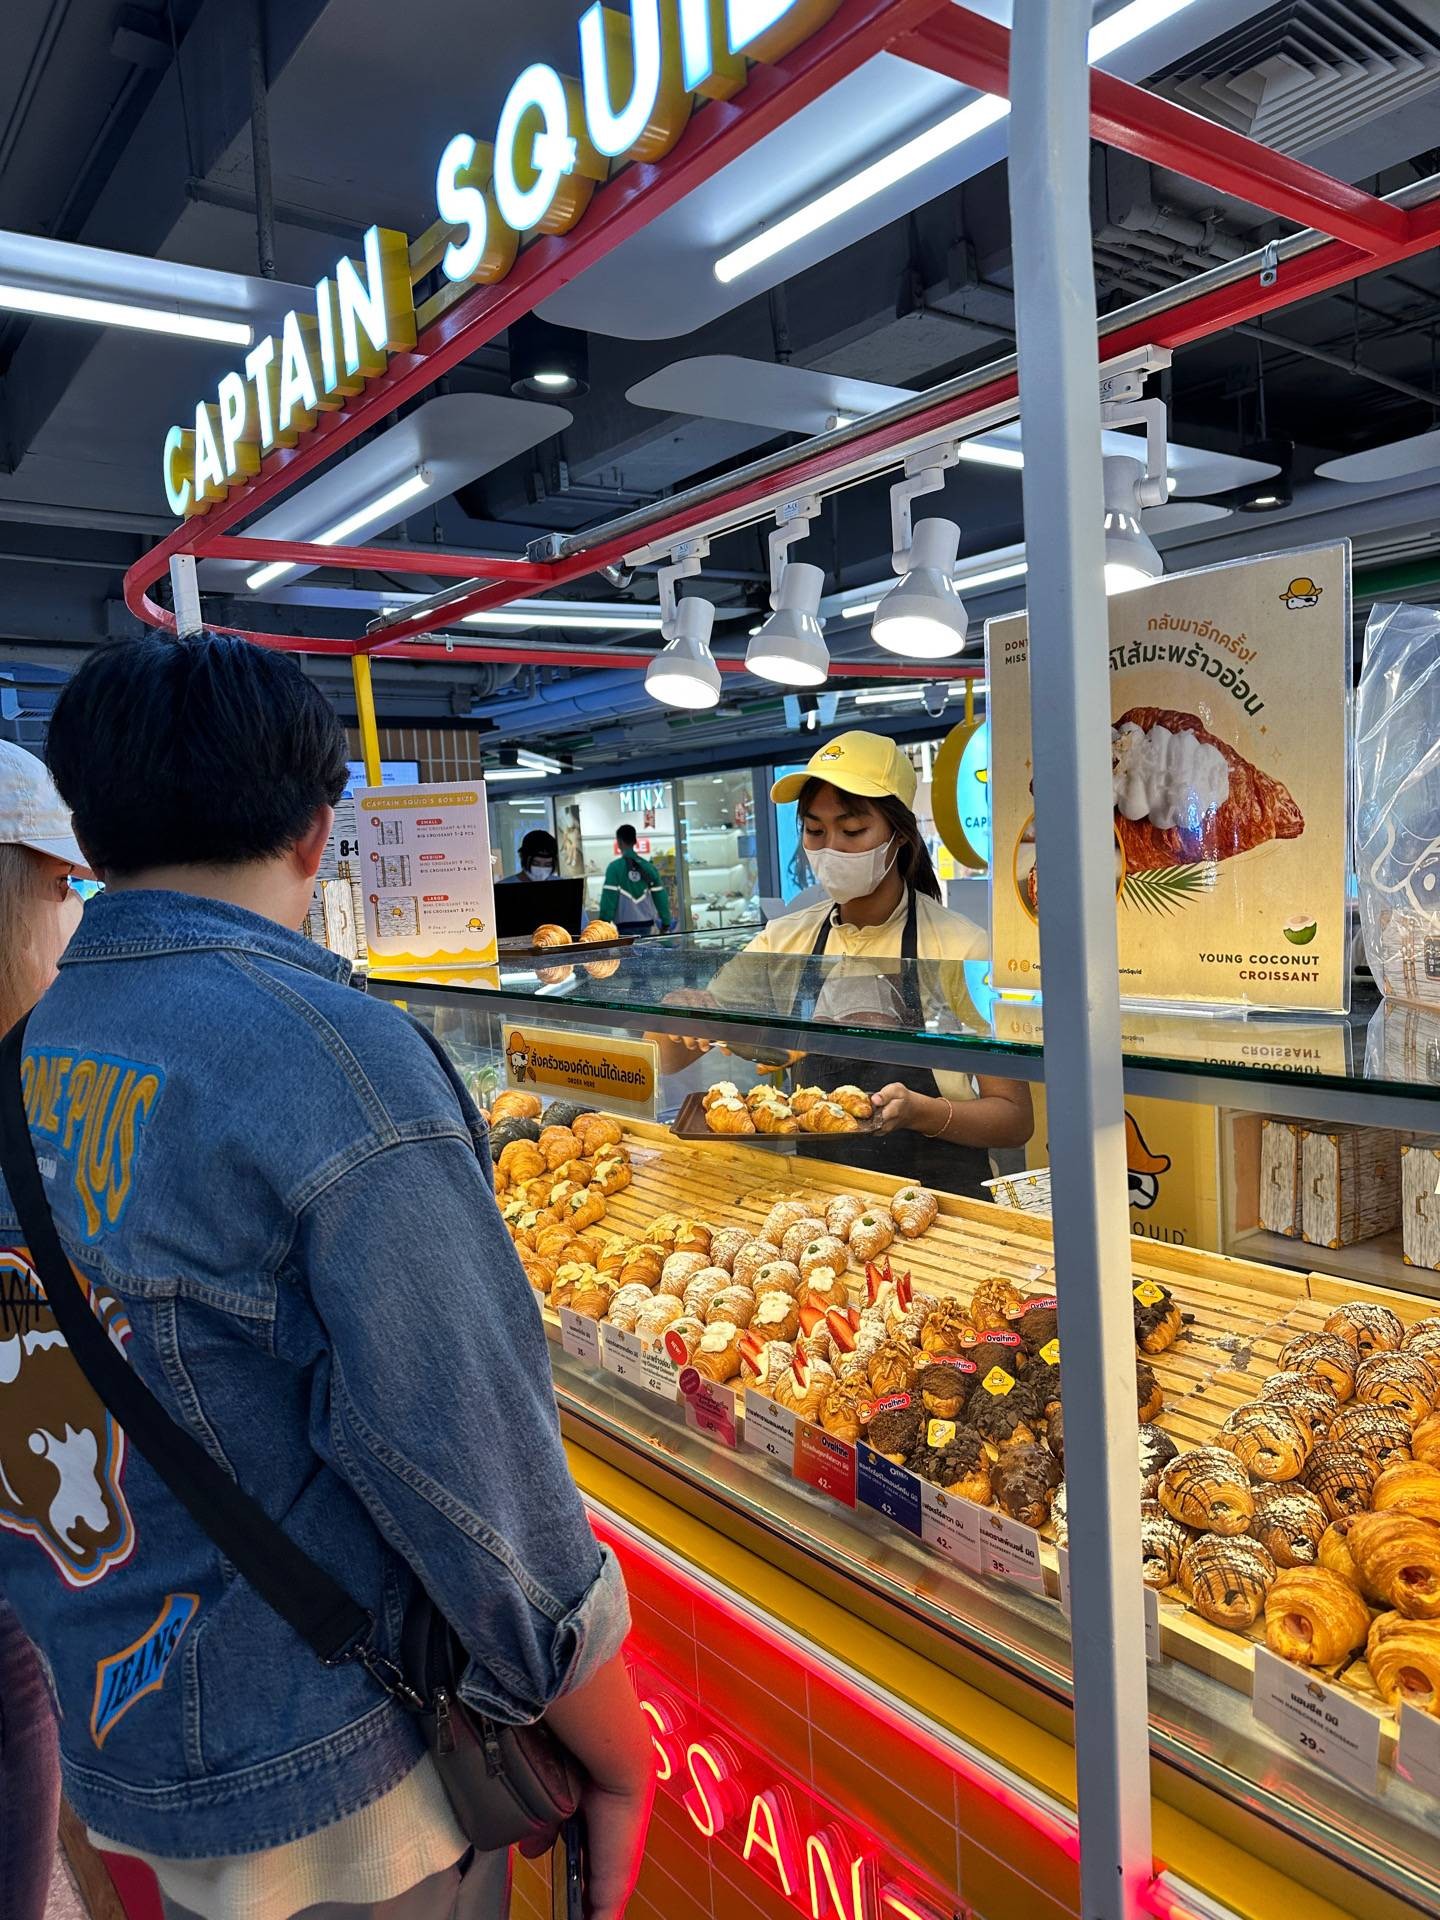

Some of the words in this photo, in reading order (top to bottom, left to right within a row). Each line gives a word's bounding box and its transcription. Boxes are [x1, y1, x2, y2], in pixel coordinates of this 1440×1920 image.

[163, 224, 390, 517] CAPTAIN
[1147, 613, 1258, 665] กลับมาอีกครั้ง!
[1005, 652, 1027, 665] MISS
[366, 799, 400, 808] CAPTAIN
[619, 787, 665, 813] MINX
[965, 816, 991, 829] CAP
[1198, 953, 1243, 964] YOUNG
[1249, 954, 1320, 966] COCONUT
[1239, 970, 1320, 982] CROISSANT
[567, 1076, 582, 1087] ORDER
[583, 1080, 596, 1090] HERE
[986, 1334, 1016, 1343] Ovaltine
[879, 1397, 906, 1411] Ovaltine
[821, 1436, 849, 1458] Ovaltine
[992, 1559, 1011, 1574] 35.-
[96, 1616, 183, 1737] JEANS
[1299, 1731, 1326, 1755] 29.-
